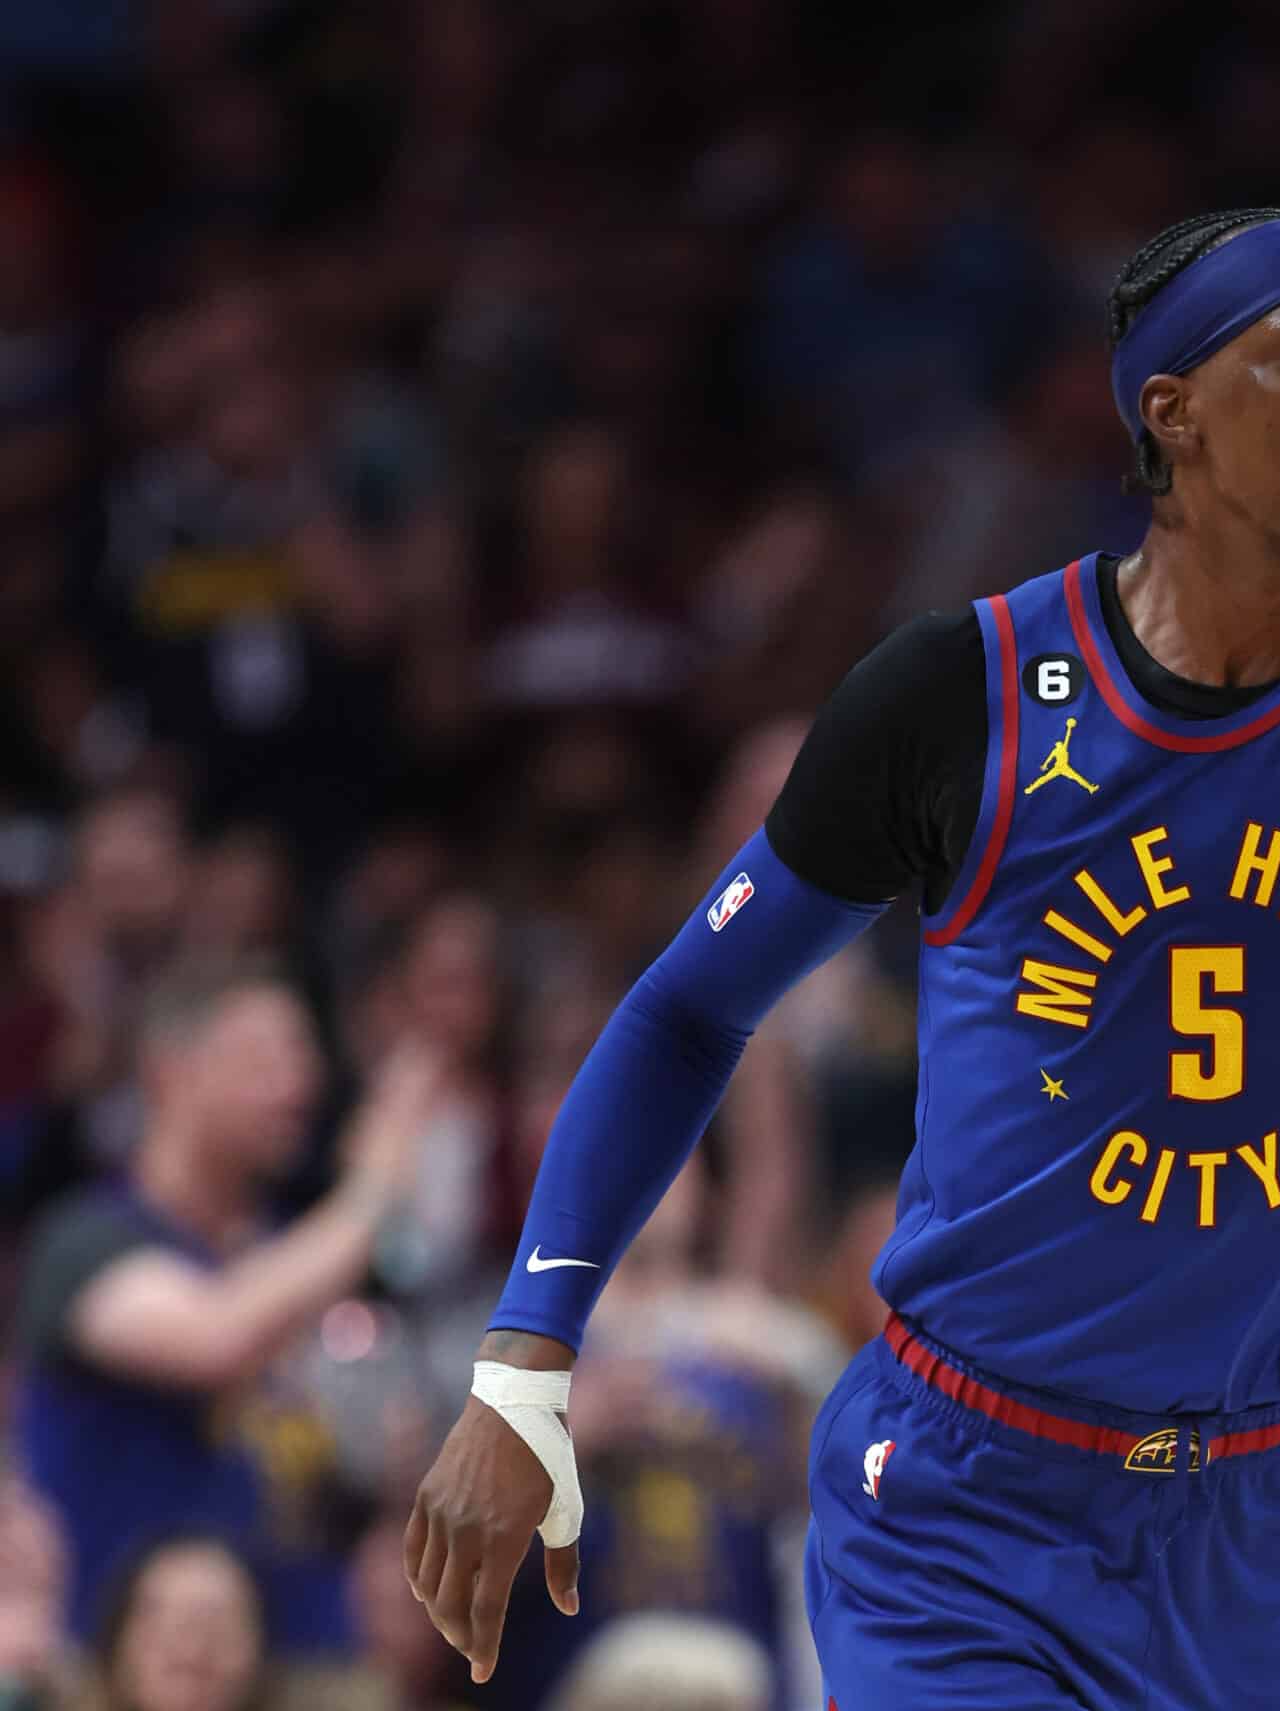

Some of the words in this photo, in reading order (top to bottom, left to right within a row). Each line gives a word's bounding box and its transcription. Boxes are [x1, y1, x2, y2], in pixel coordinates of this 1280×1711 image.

[1037, 660, 1071, 701] 6
[1015, 825, 1192, 1029] MILE
[1168, 943, 1246, 1101] 5
